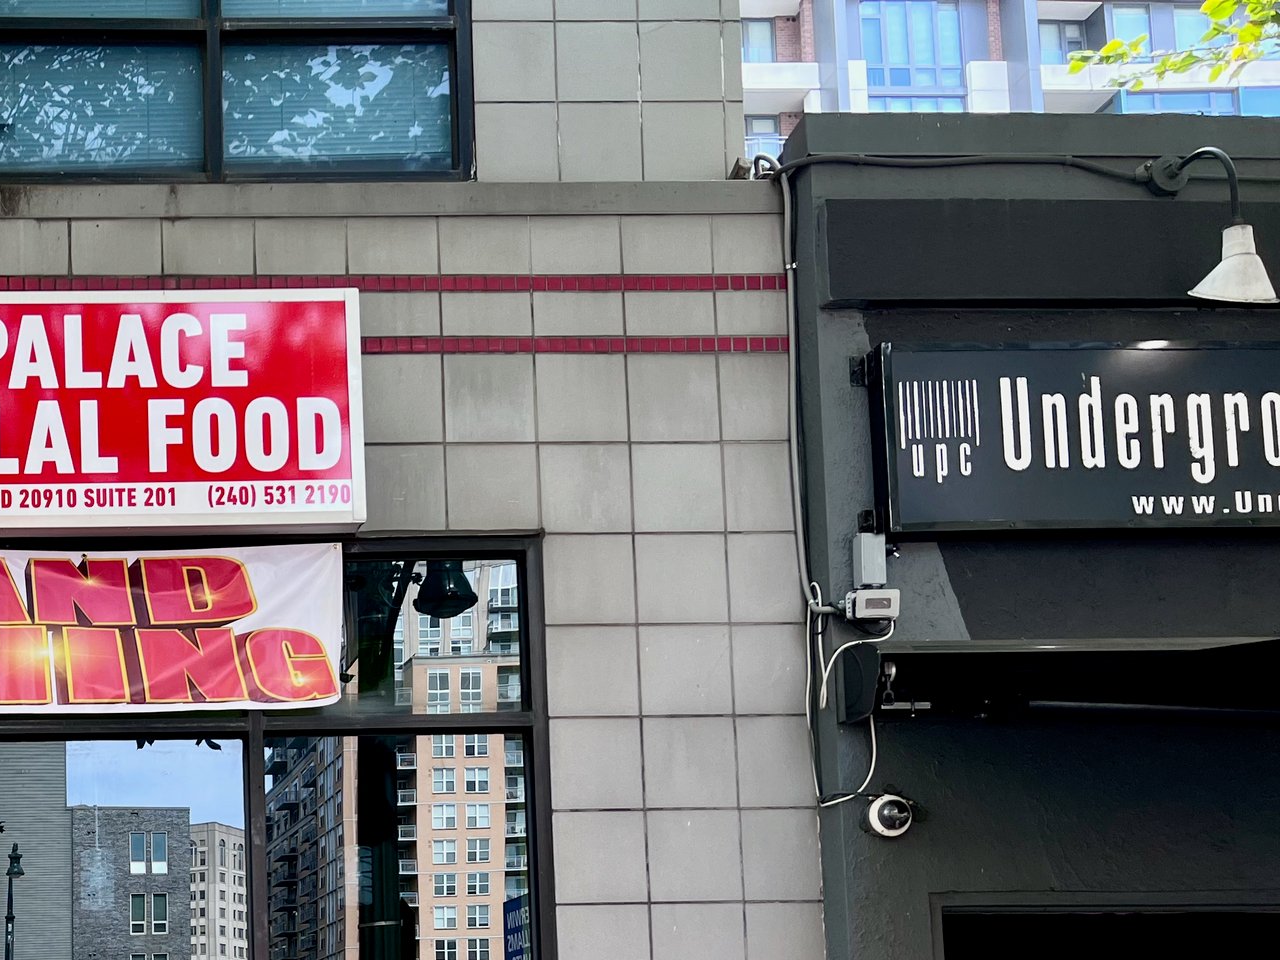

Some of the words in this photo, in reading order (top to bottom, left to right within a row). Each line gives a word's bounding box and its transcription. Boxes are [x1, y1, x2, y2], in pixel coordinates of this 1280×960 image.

[146, 396, 342, 473] FOOD
[999, 375, 1280, 484] Undergro
[912, 442, 972, 484] upc
[19, 488, 77, 508] 20910
[83, 488, 137, 508] SUITE
[144, 487, 177, 507] 201
[207, 485, 257, 507] (240)
[264, 485, 297, 505] 531
[304, 484, 351, 504] 2190
[1131, 491, 1280, 515] www.Un
